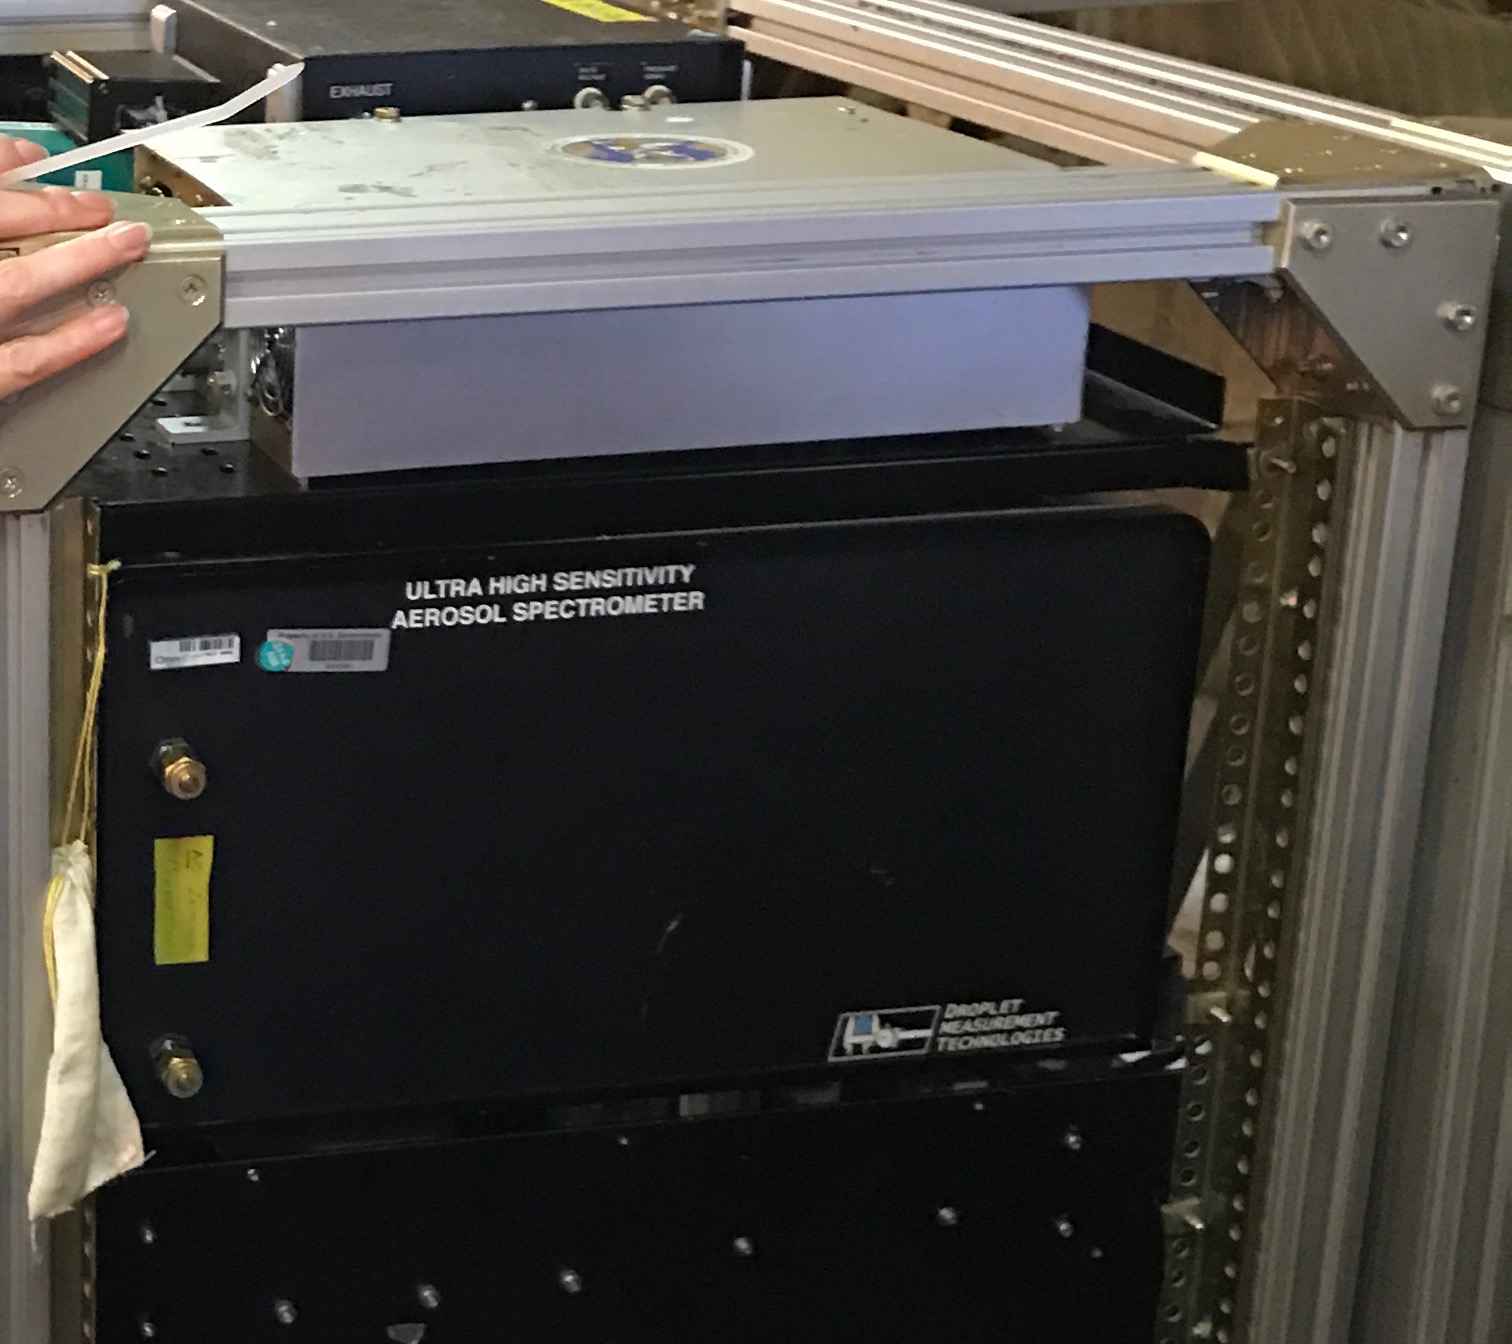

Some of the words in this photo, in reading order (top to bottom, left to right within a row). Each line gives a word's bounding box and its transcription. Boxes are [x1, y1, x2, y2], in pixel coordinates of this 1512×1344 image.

[328, 82, 394, 100] EXHAUST
[405, 577, 484, 601] ULTRA
[488, 572, 548, 596] HIGH
[552, 563, 697, 592] SENSITIVITY
[391, 603, 508, 630] AEROSOL
[512, 590, 706, 623] SPECTROMETER
[944, 998, 1026, 1019] DROPLET
[938, 1026, 1067, 1052] TECHNOLOGIES
